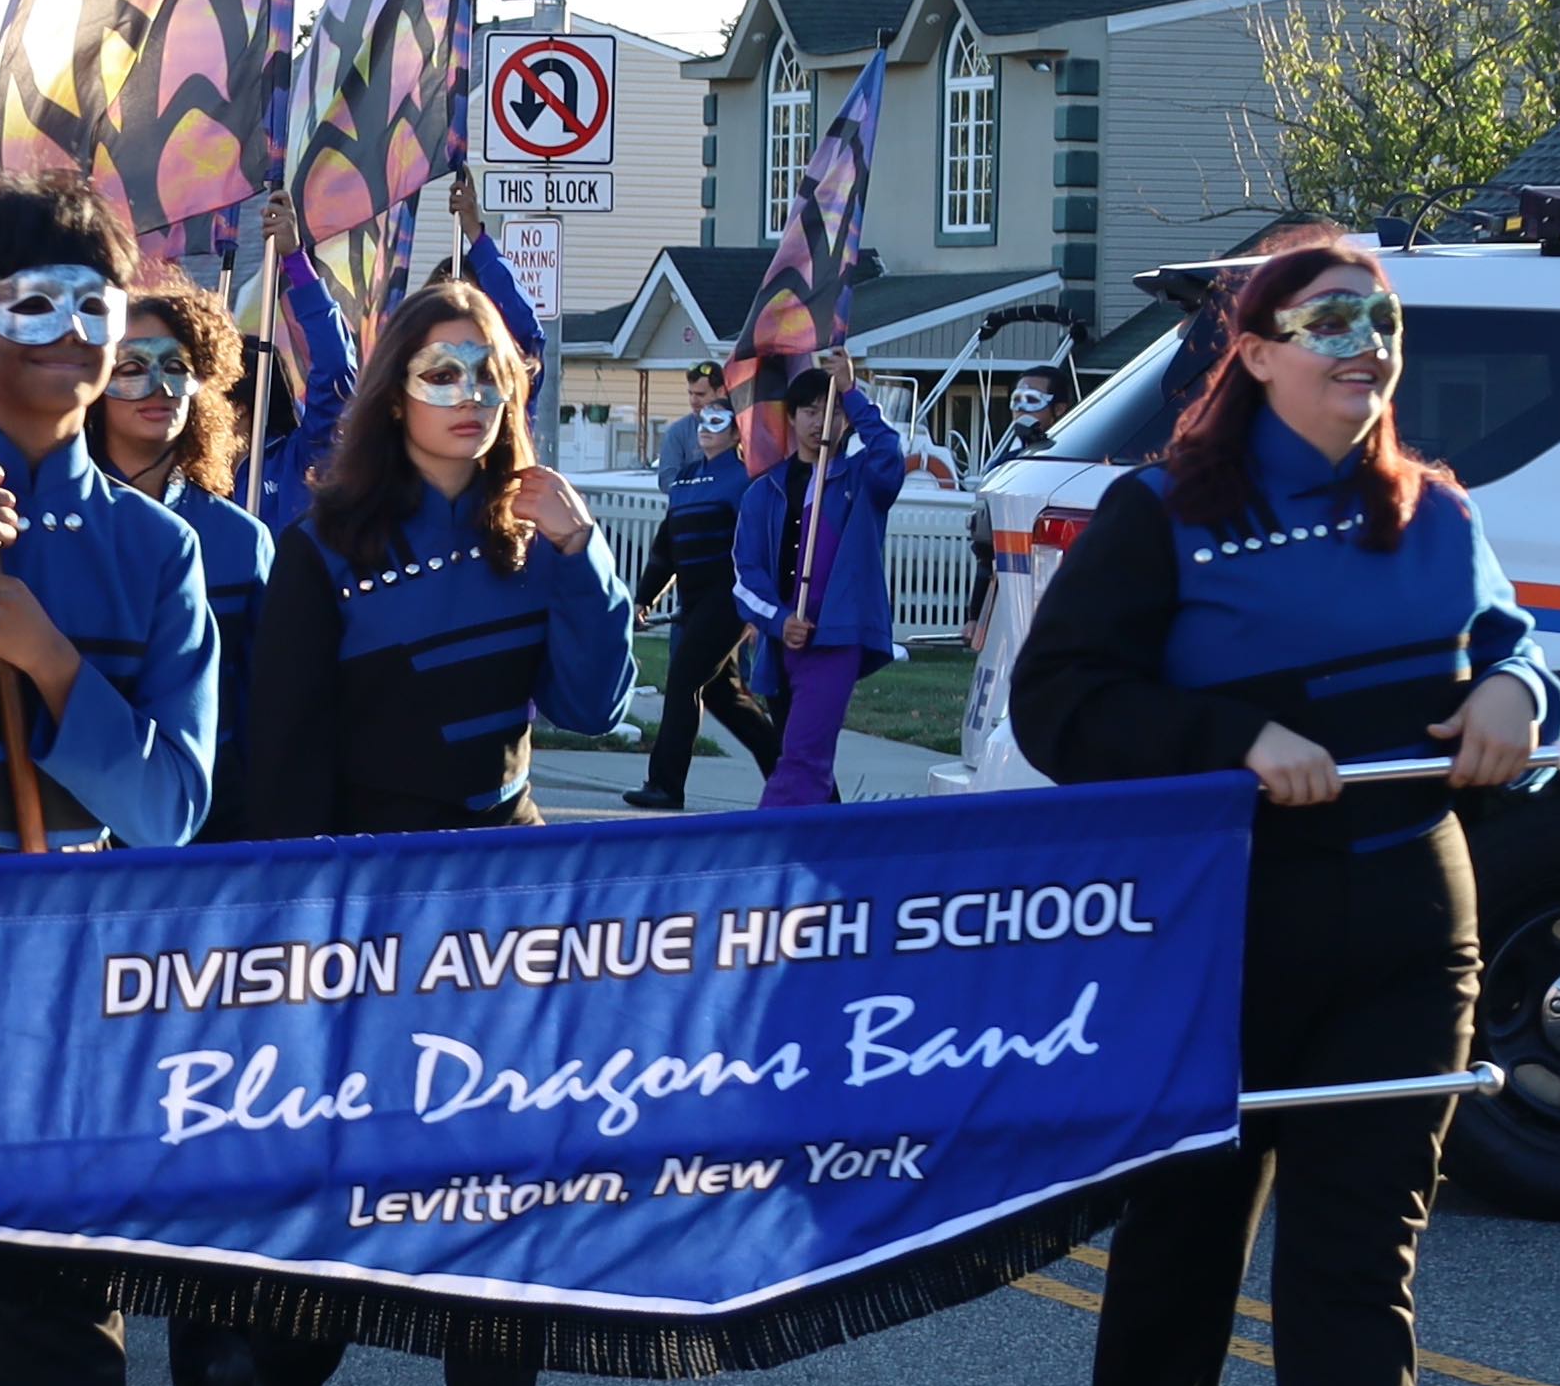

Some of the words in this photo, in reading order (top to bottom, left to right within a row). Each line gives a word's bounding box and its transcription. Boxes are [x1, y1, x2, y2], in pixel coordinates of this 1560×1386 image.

[498, 179, 533, 204] THIS
[545, 179, 599, 204] BLOCK
[520, 229, 542, 248] NO
[520, 270, 542, 284] ANY
[104, 936, 399, 1014] DIVISION
[419, 915, 695, 991] AVENUE
[717, 901, 870, 966] HIGH
[894, 881, 1154, 951] SCHOOL
[157, 1044, 373, 1145] Blue
[412, 1033, 810, 1137] Dragons
[842, 981, 1099, 1087] Band
[348, 1171, 630, 1228] Levittown,
[652, 1155, 785, 1196] New
[804, 1135, 928, 1184] York
